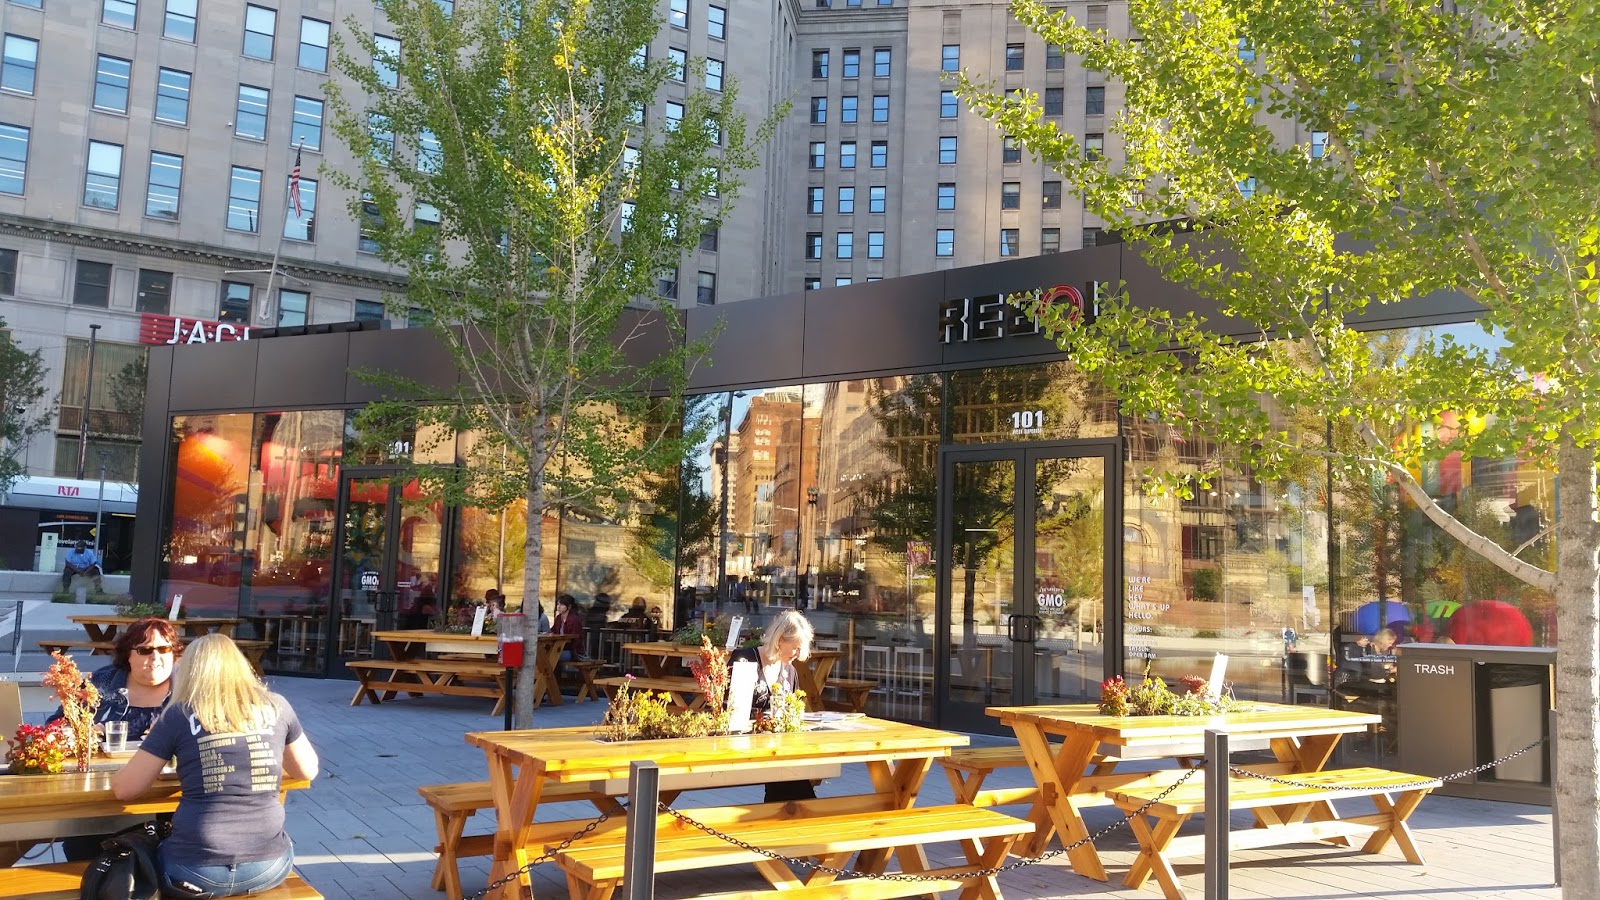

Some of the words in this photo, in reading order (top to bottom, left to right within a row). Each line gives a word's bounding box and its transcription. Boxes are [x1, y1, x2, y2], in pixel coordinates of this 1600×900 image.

[1012, 410, 1043, 428] 101
[58, 486, 80, 496] RTA
[1038, 594, 1066, 607] GMOs
[1414, 664, 1454, 675] TRASH
